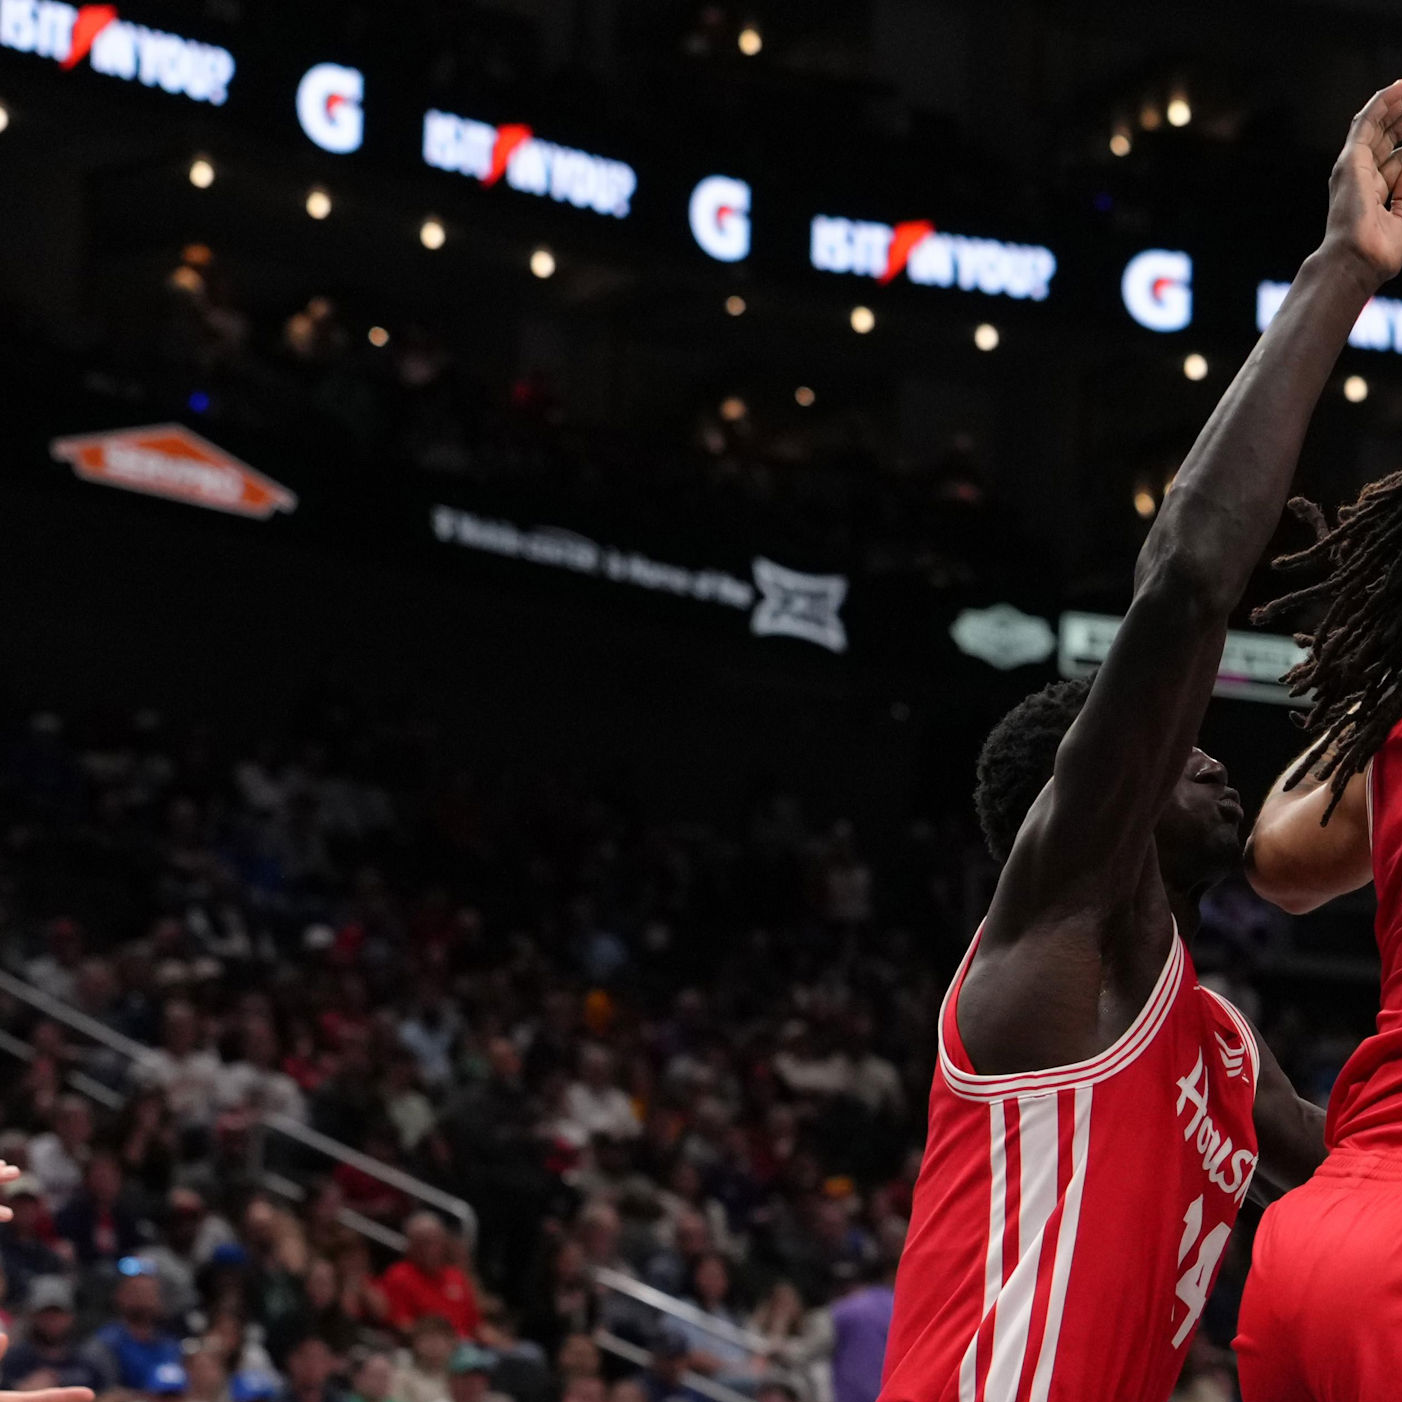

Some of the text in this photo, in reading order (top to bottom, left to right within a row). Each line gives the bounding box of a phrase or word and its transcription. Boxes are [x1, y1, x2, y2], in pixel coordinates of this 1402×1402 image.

[297, 63, 363, 153] G
[689, 174, 750, 262] G
[1121, 248, 1193, 333] G
[1171, 1194, 1231, 1350] 14
